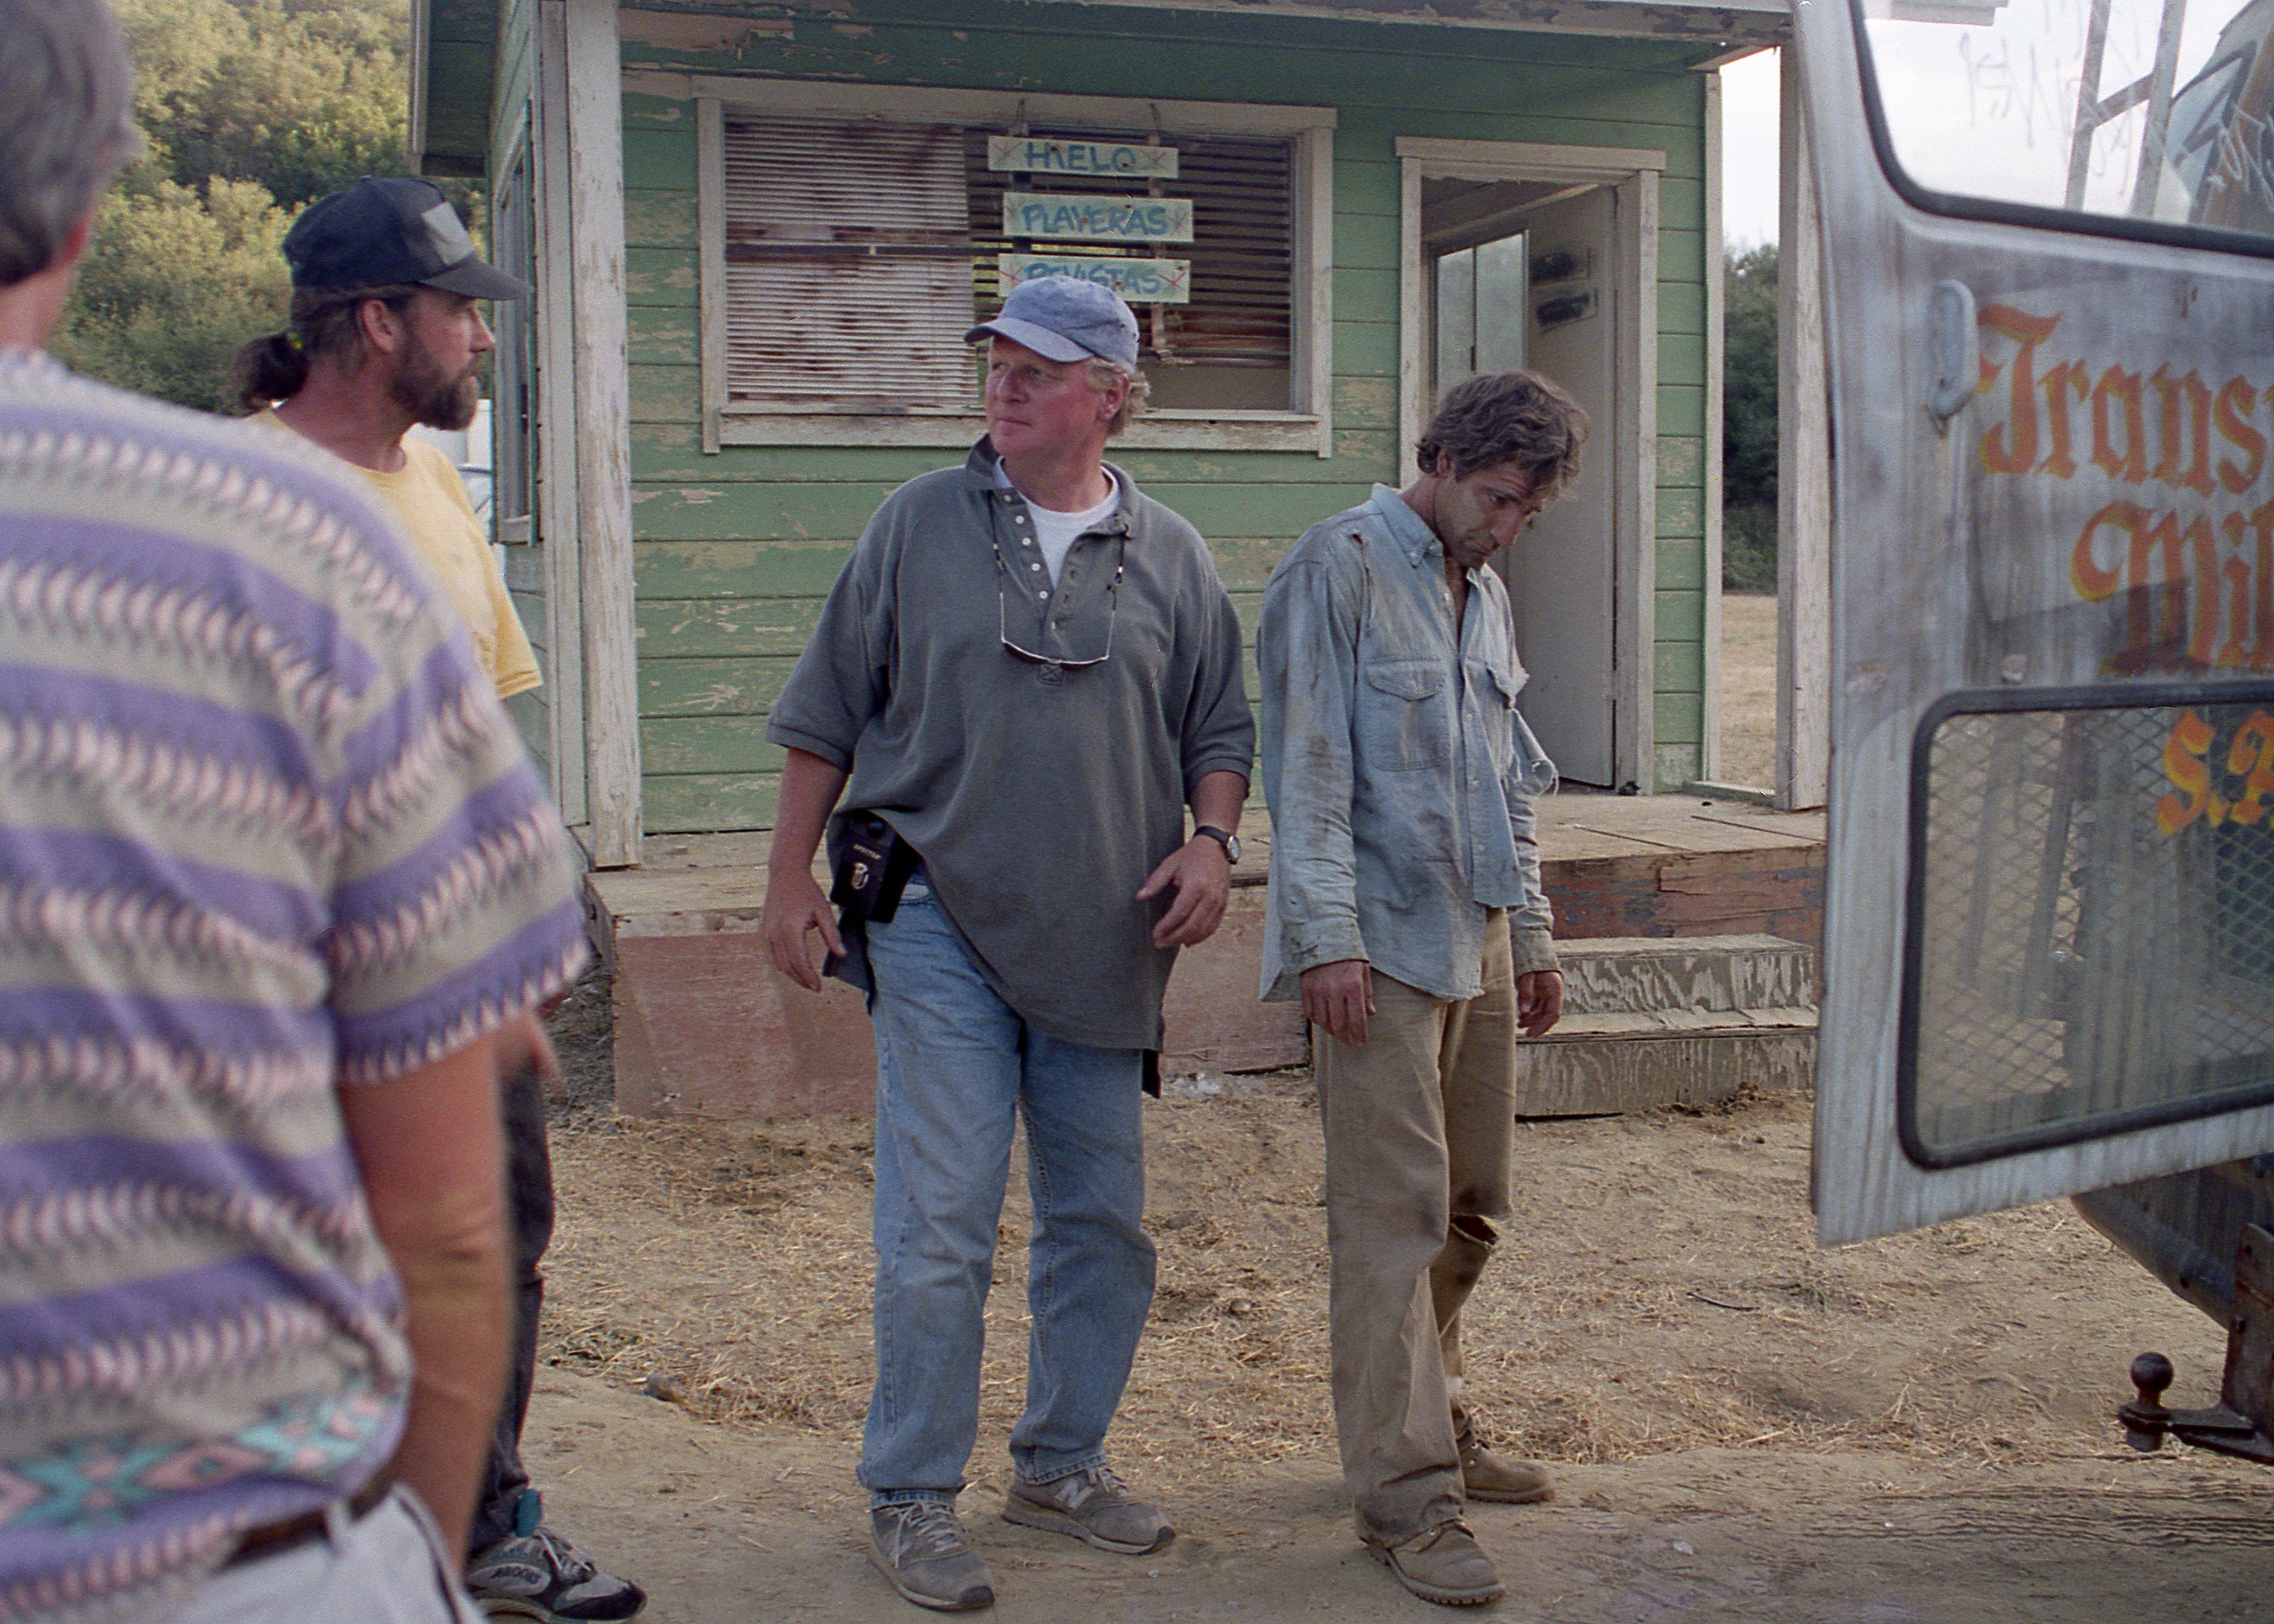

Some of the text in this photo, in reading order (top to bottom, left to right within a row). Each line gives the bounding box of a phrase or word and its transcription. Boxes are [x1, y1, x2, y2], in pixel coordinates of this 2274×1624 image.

[1024, 141, 1137, 173] HIELO
[1021, 203, 1170, 236] PLAYERAS
[1977, 302, 2274, 498] Trans
